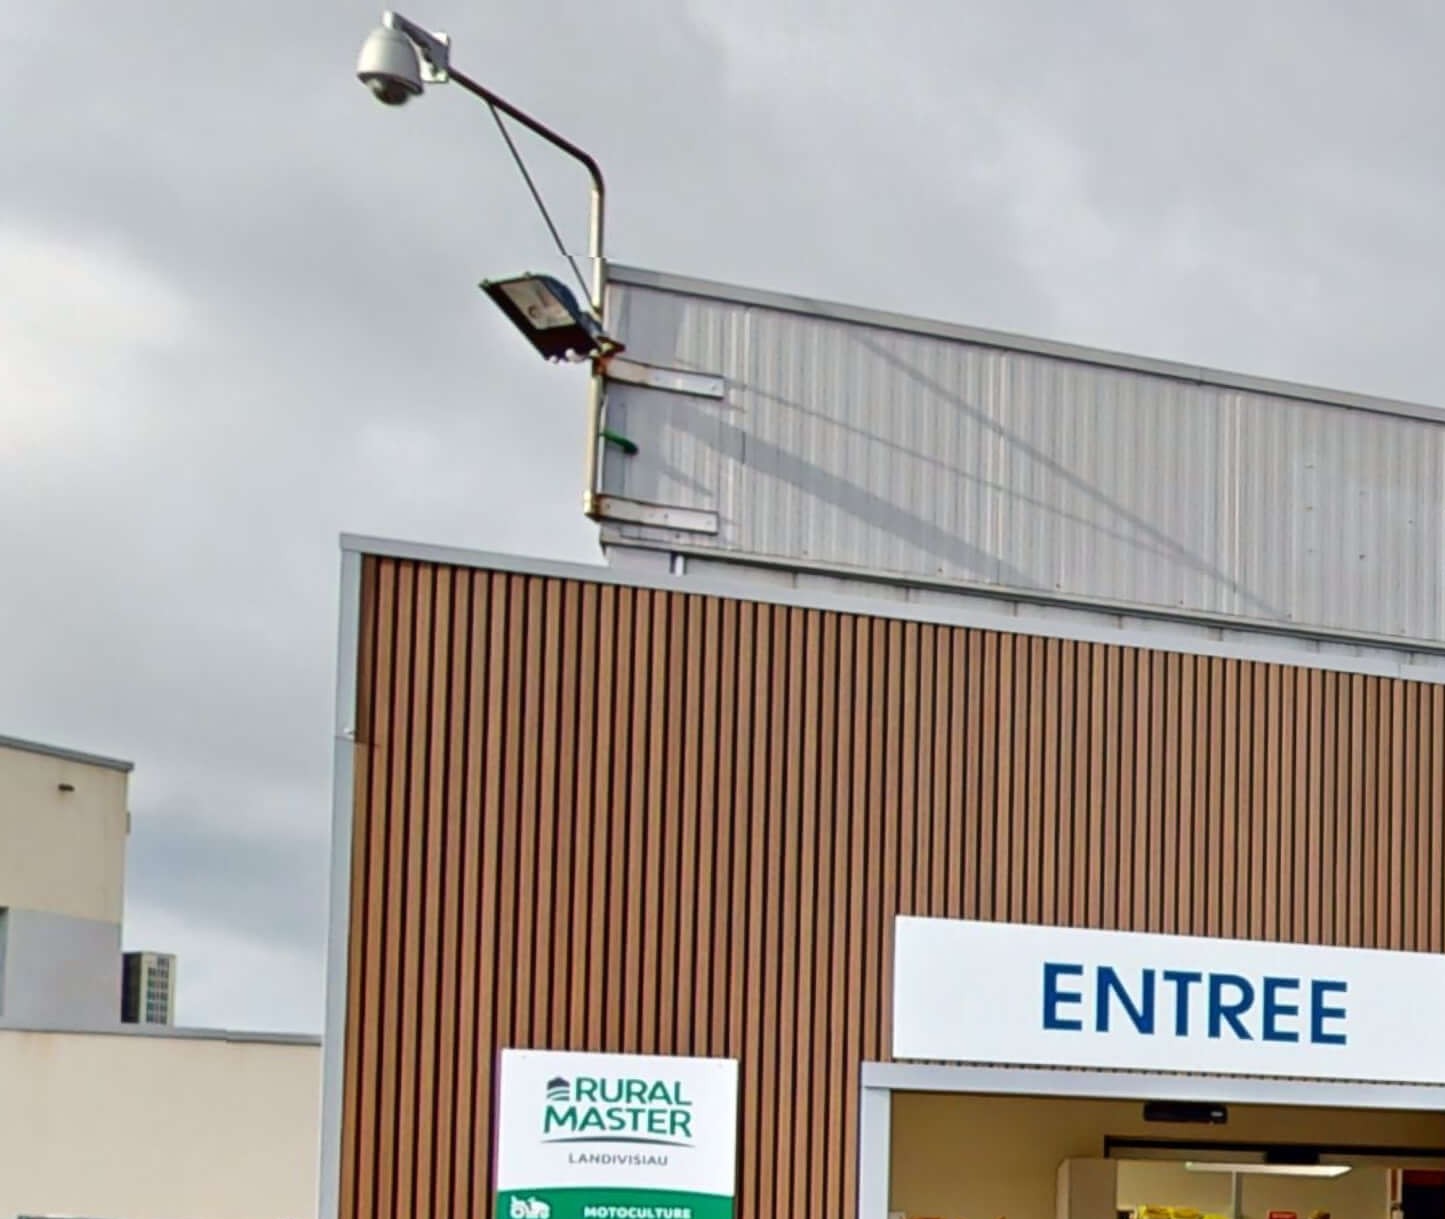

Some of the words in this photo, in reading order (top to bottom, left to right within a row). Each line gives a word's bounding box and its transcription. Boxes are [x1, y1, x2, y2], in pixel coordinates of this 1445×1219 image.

[1043, 962, 1347, 1045] ENTREE
[575, 1077, 692, 1106] RURAL
[543, 1105, 692, 1138] MASTER
[568, 1153, 669, 1167] LANDIVISIAU
